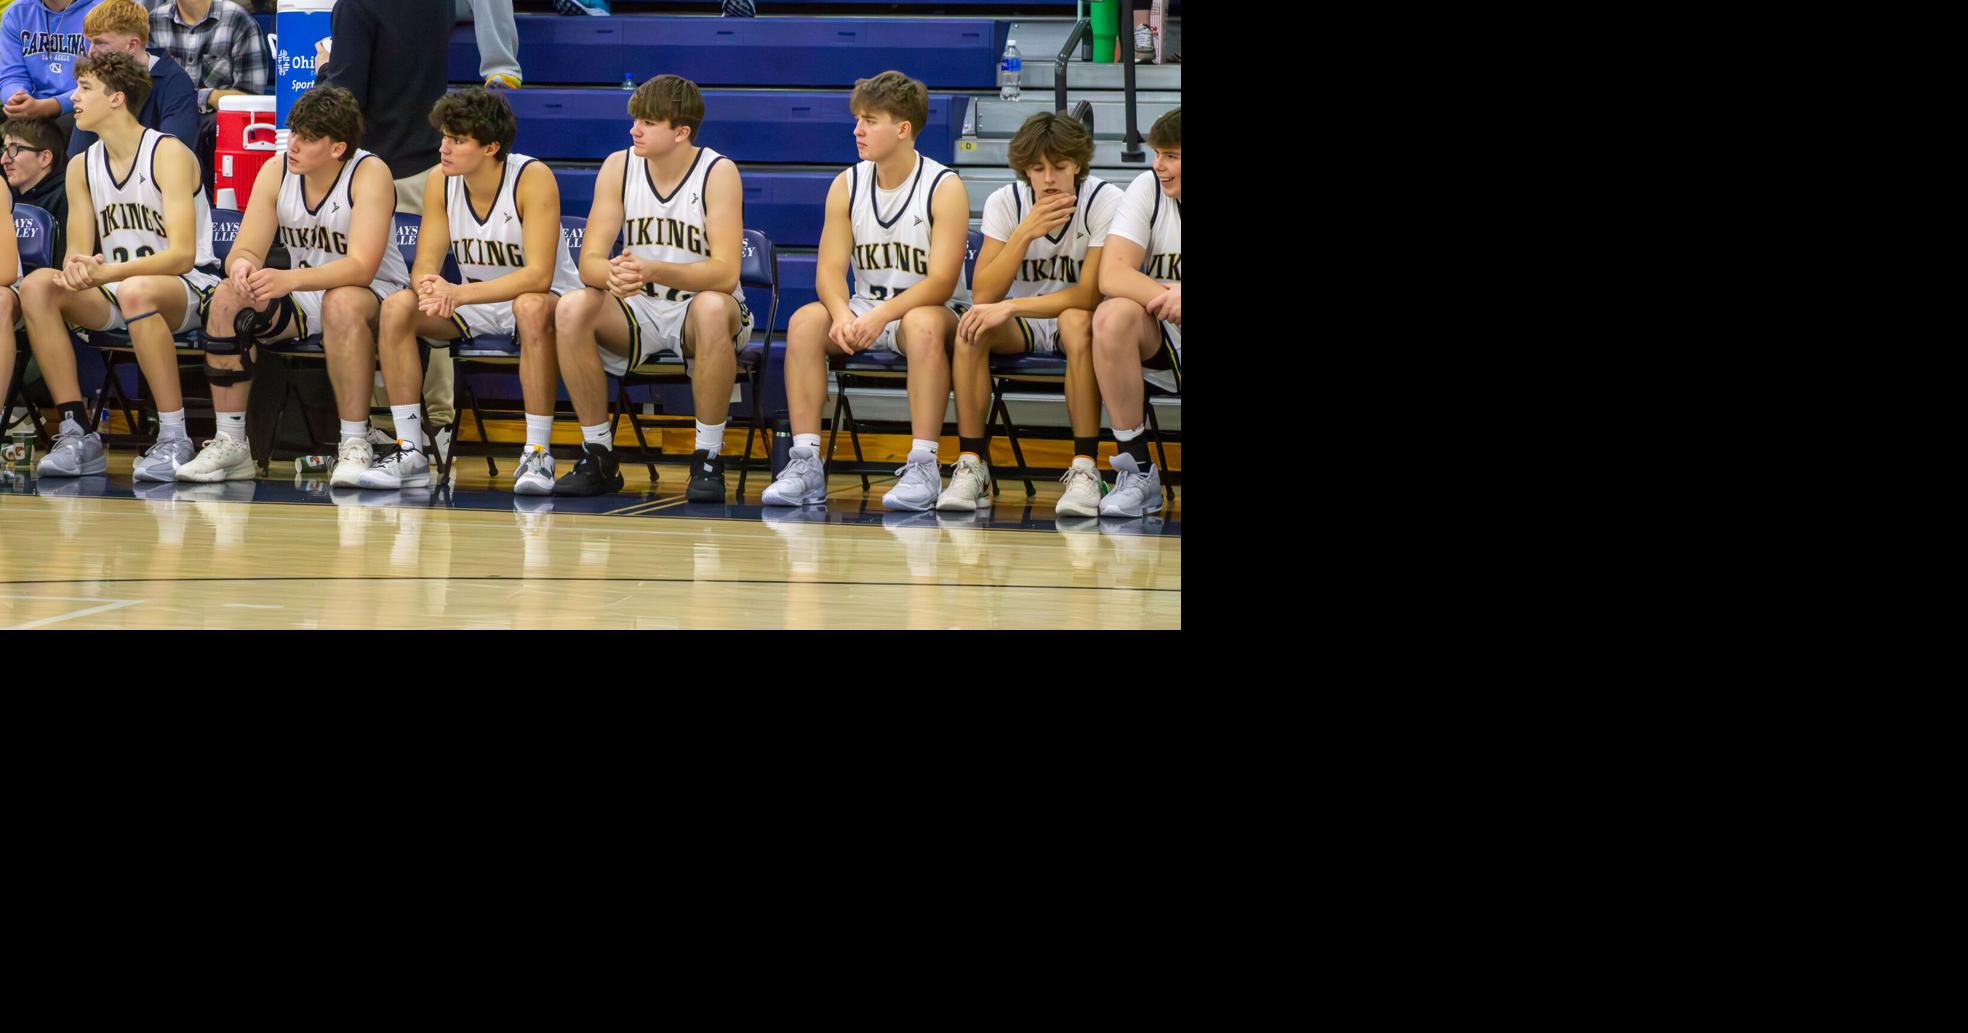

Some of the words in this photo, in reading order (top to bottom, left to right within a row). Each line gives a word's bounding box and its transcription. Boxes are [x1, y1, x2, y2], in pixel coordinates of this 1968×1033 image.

[21, 30, 88, 58] CAROLINA
[292, 56, 315, 69] Ohi
[292, 80, 315, 92] Sport
[14, 218, 33, 228] AYS
[100, 203, 168, 239] IKINGS
[212, 222, 240, 232] EAYS
[397, 226, 419, 236] AYS
[16, 228, 39, 238] LEY
[281, 226, 348, 255] IKING
[562, 228, 585, 238] EAY
[626, 217, 711, 257] IKING
[453, 239, 525, 267] IKING
[856, 242, 928, 275] IKING
[1016, 255, 1084, 283] IKIN
